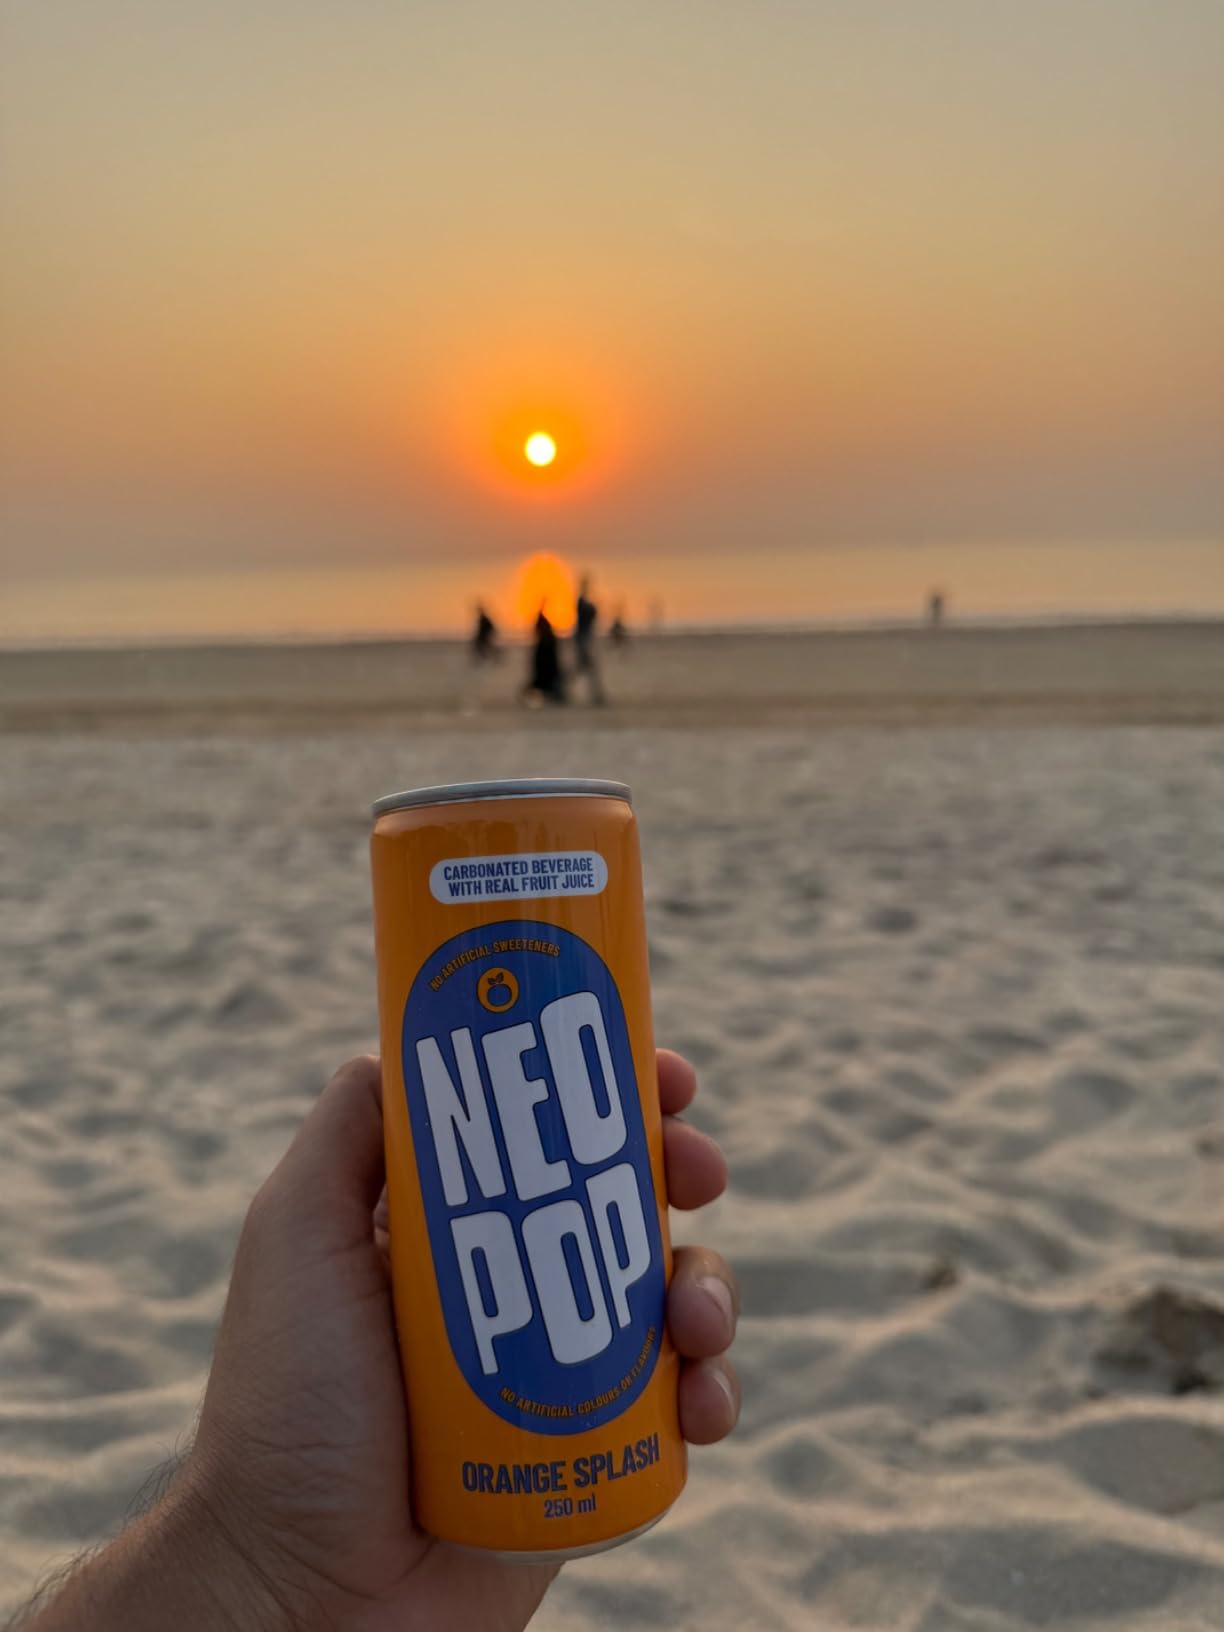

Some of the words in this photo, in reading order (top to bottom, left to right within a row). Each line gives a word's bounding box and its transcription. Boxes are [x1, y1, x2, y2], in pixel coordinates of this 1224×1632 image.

[443, 860, 529, 881] CARBONATED
[531, 857, 594, 875] BEVERAGE
[448, 878, 483, 897] WITH
[484, 877, 520, 894] REAL
[521, 875, 560, 892] FRUIT
[561, 874, 595, 889] JUICE
[429, 974, 444, 992] NO
[442, 945, 491, 978] ARTIFICIAL
[493, 939, 561, 957] SWEETENERS
[415, 991, 628, 1207] NEO
[450, 1162, 651, 1376] POP
[500, 1387, 515, 1401] NO
[516, 1397, 575, 1417] ARTIFICIAL
[577, 1387, 620, 1415] COLOURS
[620, 1376, 633, 1391] OR
[461, 1460, 567, 1495] ORANGE
[573, 1432, 660, 1488] SPLASH
[544, 1498, 573, 1518] 250
[578, 1493, 596, 1513] ml
